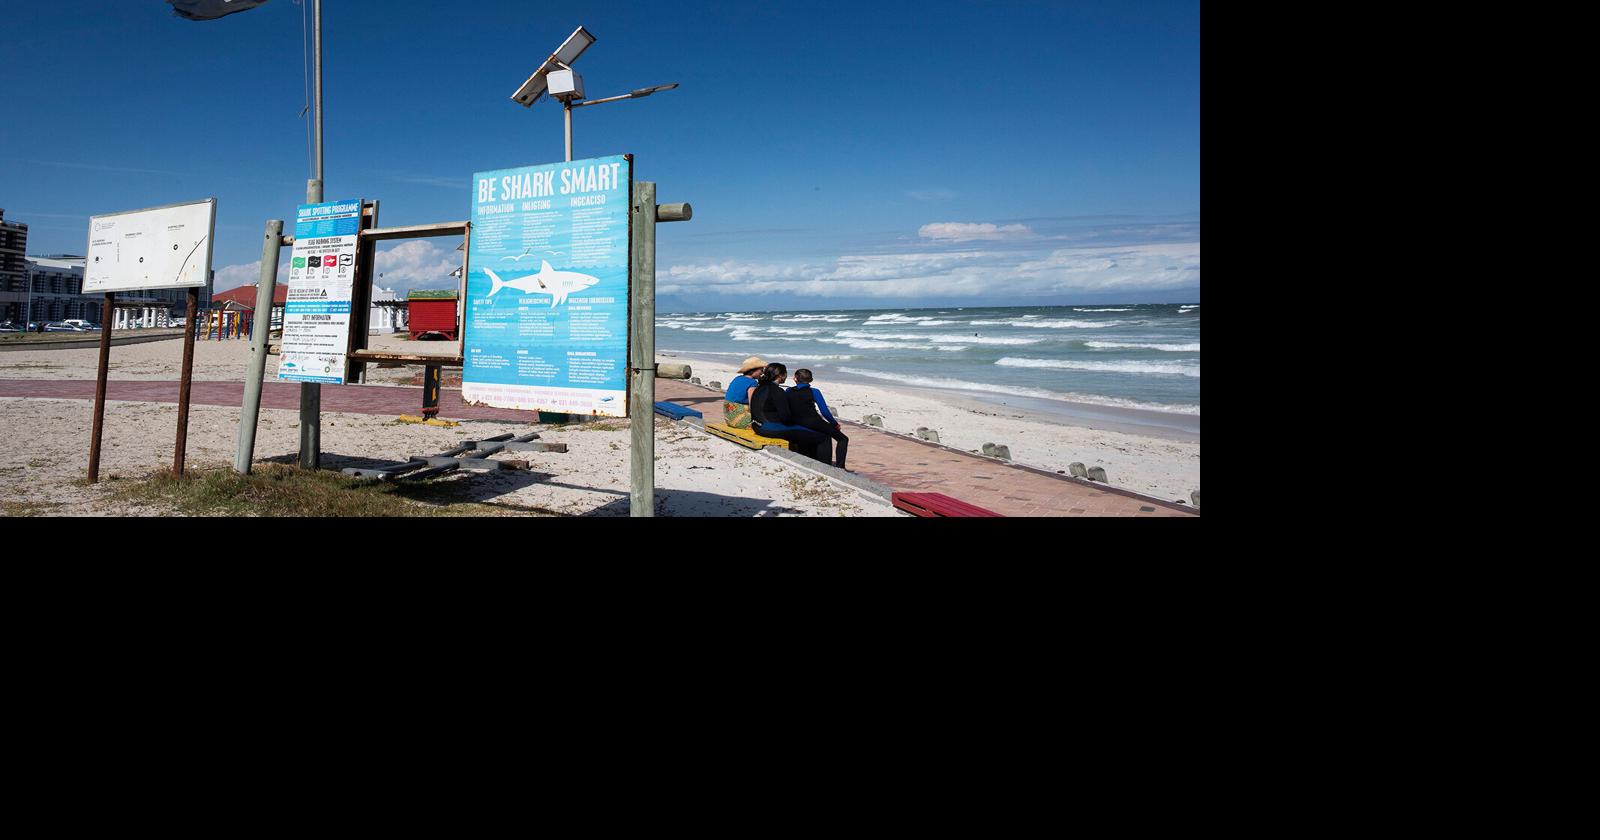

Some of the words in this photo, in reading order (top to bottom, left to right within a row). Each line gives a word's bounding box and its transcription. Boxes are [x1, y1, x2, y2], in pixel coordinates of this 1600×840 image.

[478, 177, 497, 202] BE
[501, 170, 554, 200] SHARK
[560, 163, 620, 194] SMART
[298, 208, 311, 217] SHARK
[312, 206, 331, 215] SPOTTING
[478, 203, 514, 215] INFORMATION
